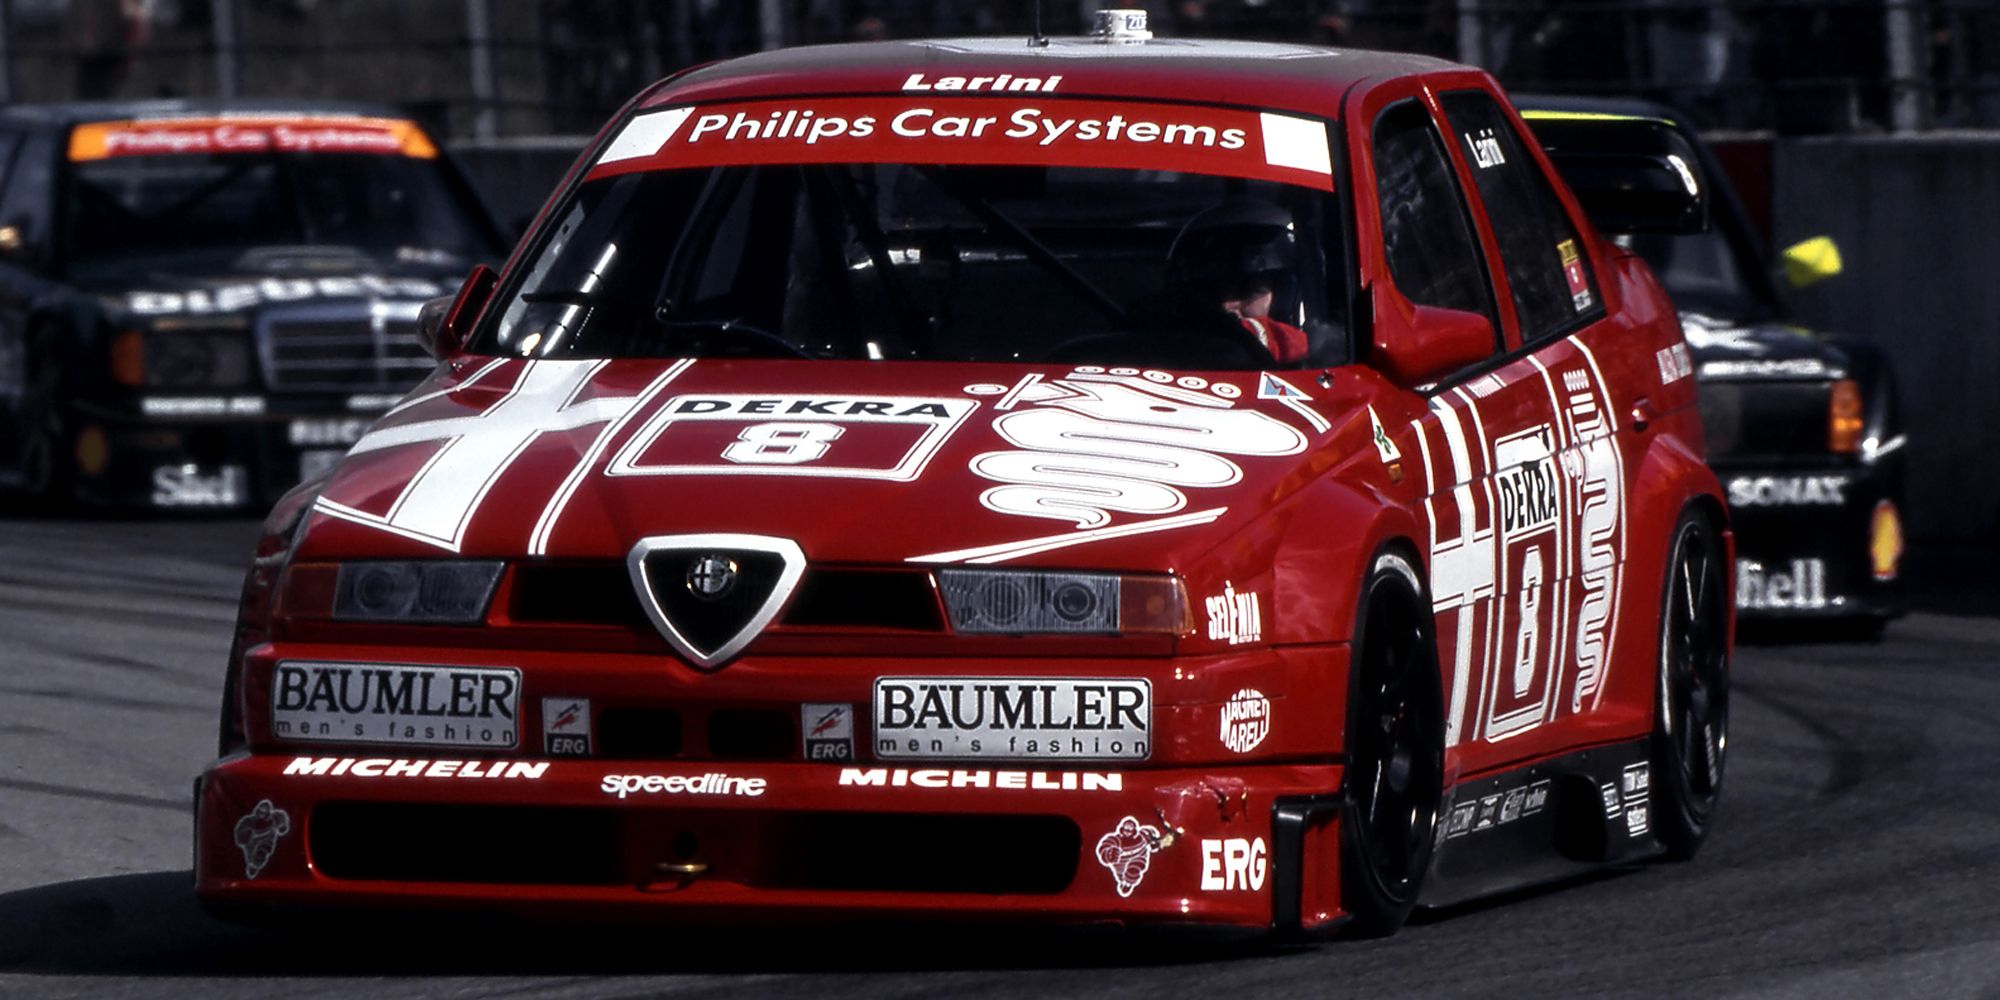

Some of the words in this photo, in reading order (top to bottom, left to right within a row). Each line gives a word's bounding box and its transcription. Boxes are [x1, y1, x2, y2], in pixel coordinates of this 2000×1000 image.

[902, 73, 1062, 93] Larini
[688, 109, 876, 144] Philips
[891, 108, 997, 138] Car
[1004, 108, 1247, 150] Systems
[1464, 128, 1506, 169] Larini
[673, 399, 951, 418] DEKRA
[720, 422, 847, 464] 8
[1499, 461, 1559, 533] DEKRA
[1736, 558, 1827, 609] hell
[1514, 545, 1543, 699] 8
[275, 666, 514, 720] BÄUMLER
[879, 684, 1147, 731] BÄUMLER
[276, 718, 364, 736] men's
[388, 721, 513, 743] fashion
[552, 738, 586, 754] ERG
[879, 735, 981, 753] men's
[1009, 735, 1146, 754] fashion
[283, 756, 550, 780] MICHELIN
[812, 743, 848, 759] ERG
[601, 772, 767, 799] speedline
[838, 767, 1123, 793] MICHELIN
[1200, 836, 1267, 892] ERG
